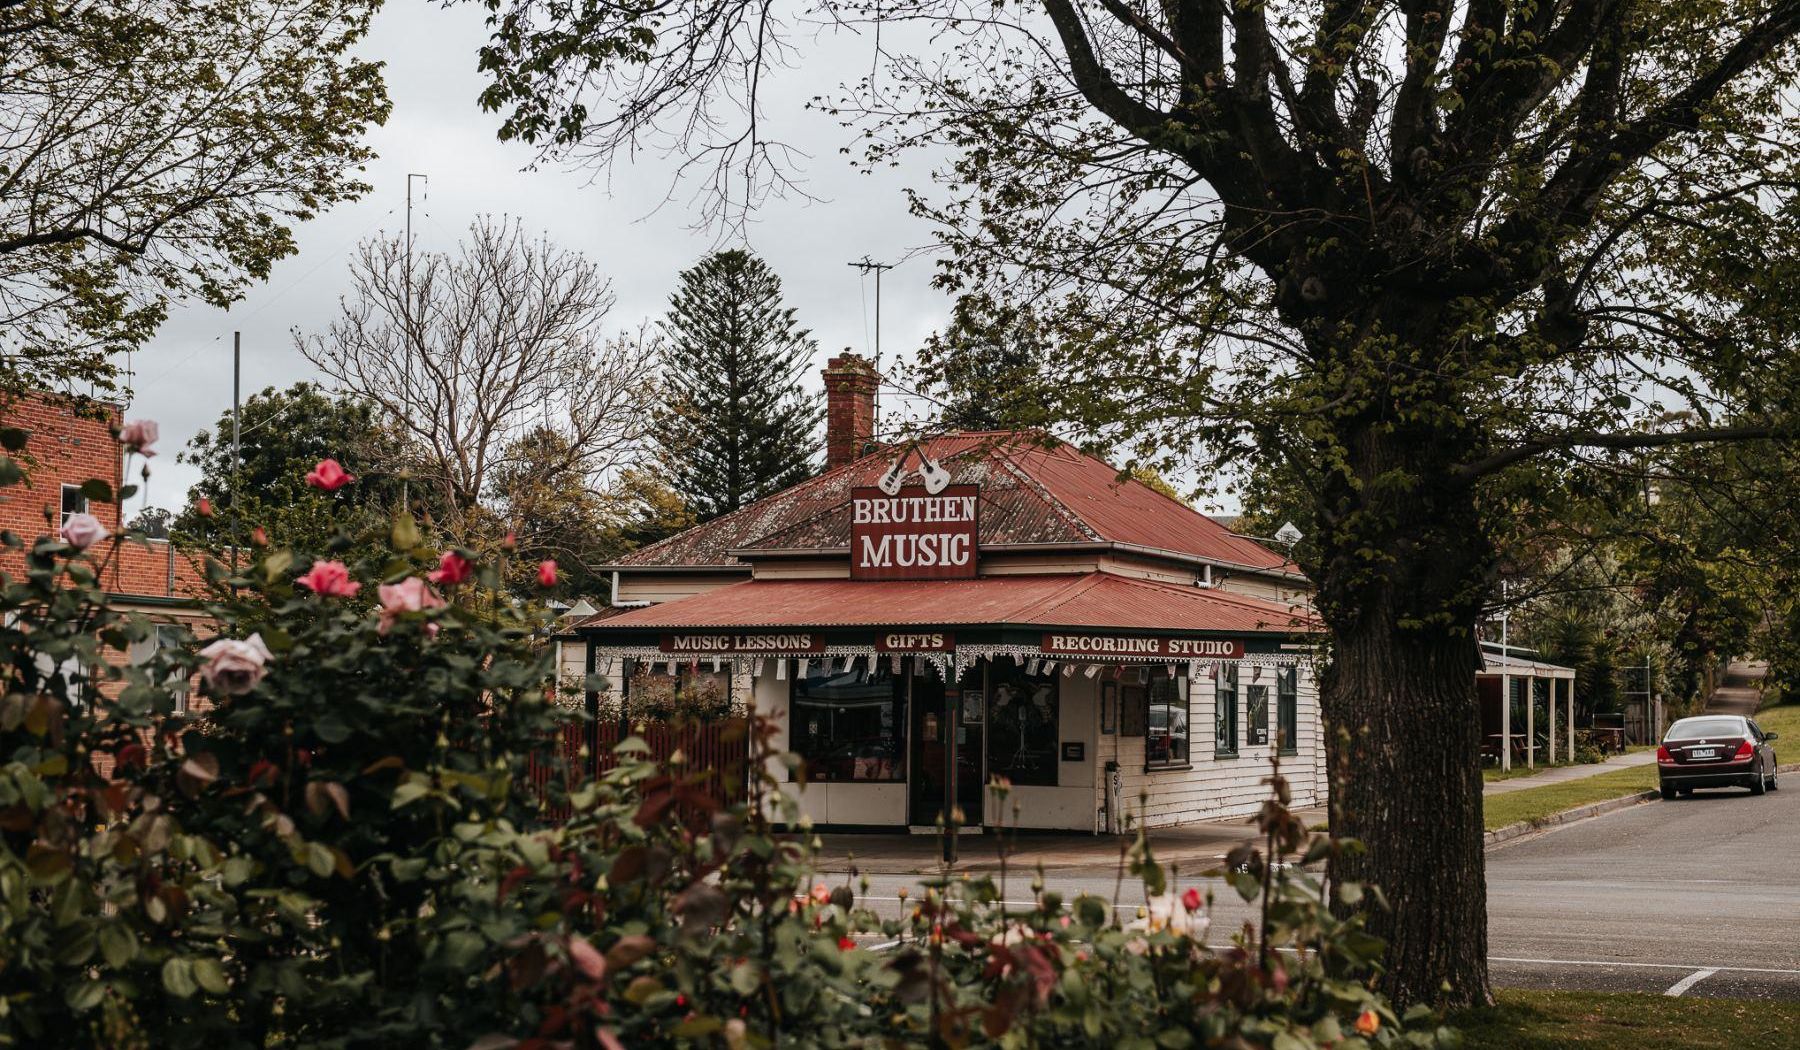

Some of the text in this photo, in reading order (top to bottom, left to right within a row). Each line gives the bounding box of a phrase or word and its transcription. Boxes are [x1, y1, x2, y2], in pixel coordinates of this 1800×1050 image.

[853, 496, 977, 524] BRUTHEN
[860, 533, 970, 568] MUSIC
[673, 634, 812, 650] MUSIC LESSONS
[886, 633, 944, 649] GIFTS
[1051, 635, 1234, 655] RECORDING STUDIO
